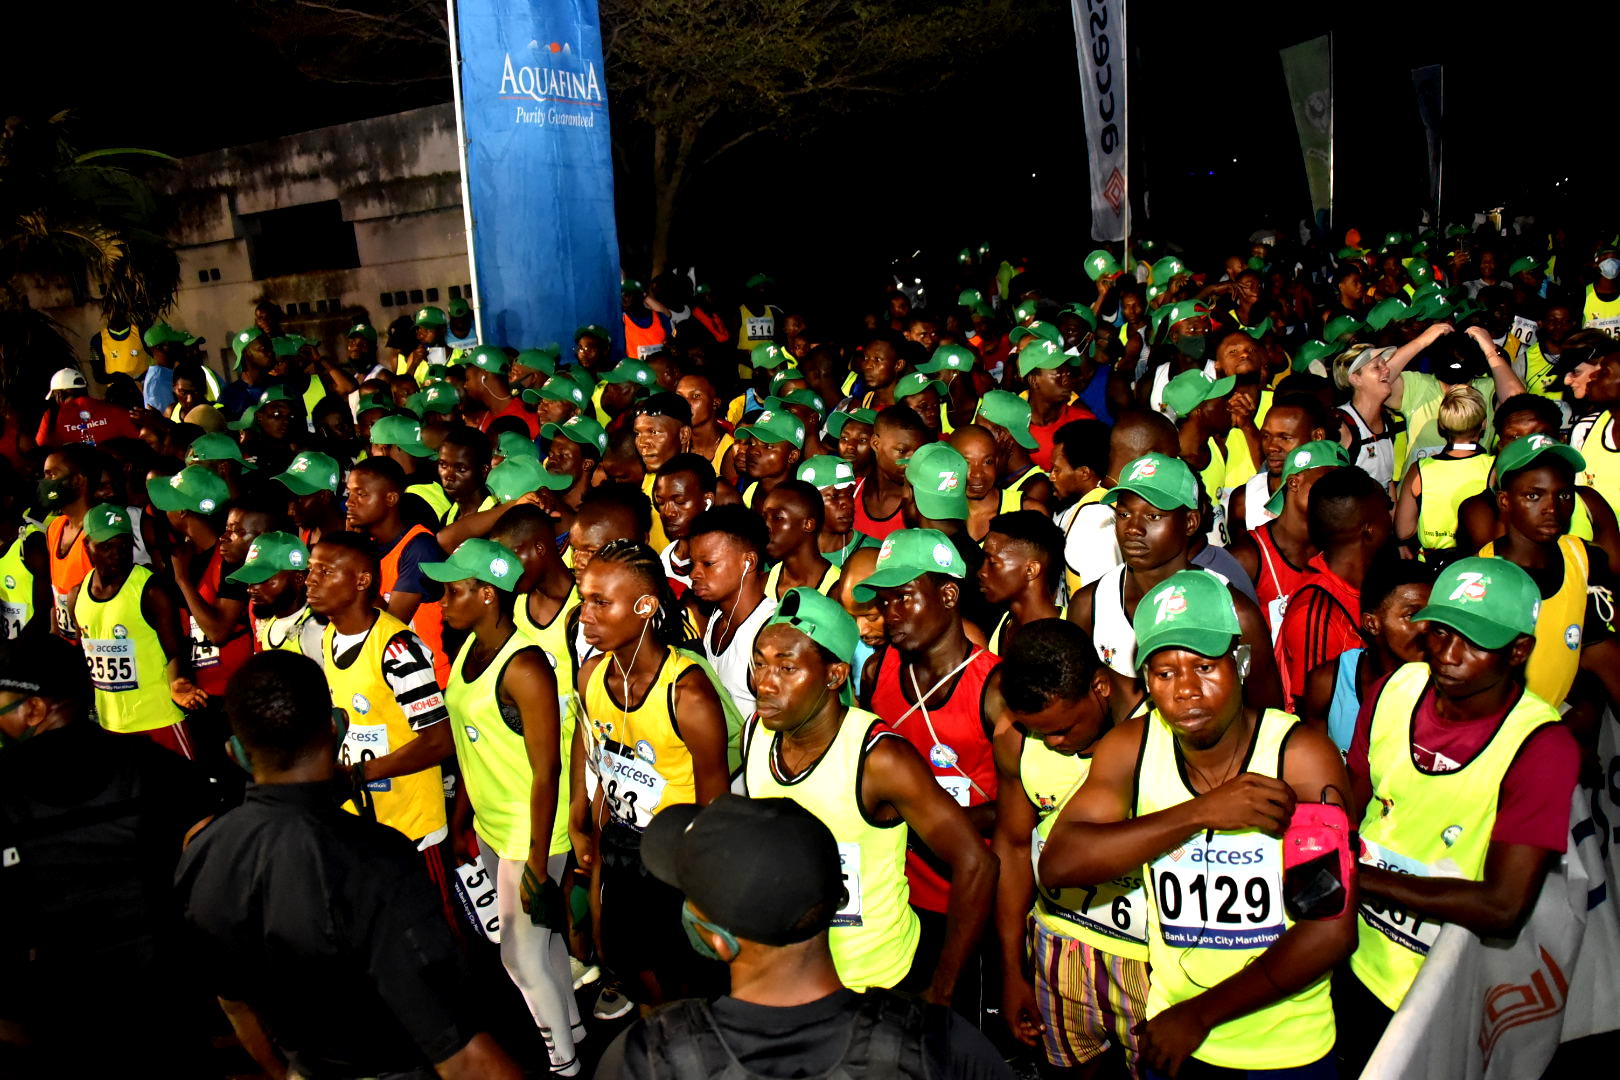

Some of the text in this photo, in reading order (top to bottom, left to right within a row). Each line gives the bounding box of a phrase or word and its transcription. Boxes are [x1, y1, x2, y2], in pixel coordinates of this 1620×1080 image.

[499, 52, 602, 102] AQUAFINA
[516, 106, 594, 127] Purity Guaranteed
[751, 325, 771, 336] 514
[96, 644, 128, 653] access
[86, 656, 132, 680] 2555
[410, 696, 441, 712] KOHLER
[614, 762, 657, 788] access
[1190, 847, 1264, 866] access
[1159, 870, 1271, 924] 0129
[1164, 931, 1281, 947] Bank Lagos City Marathon
